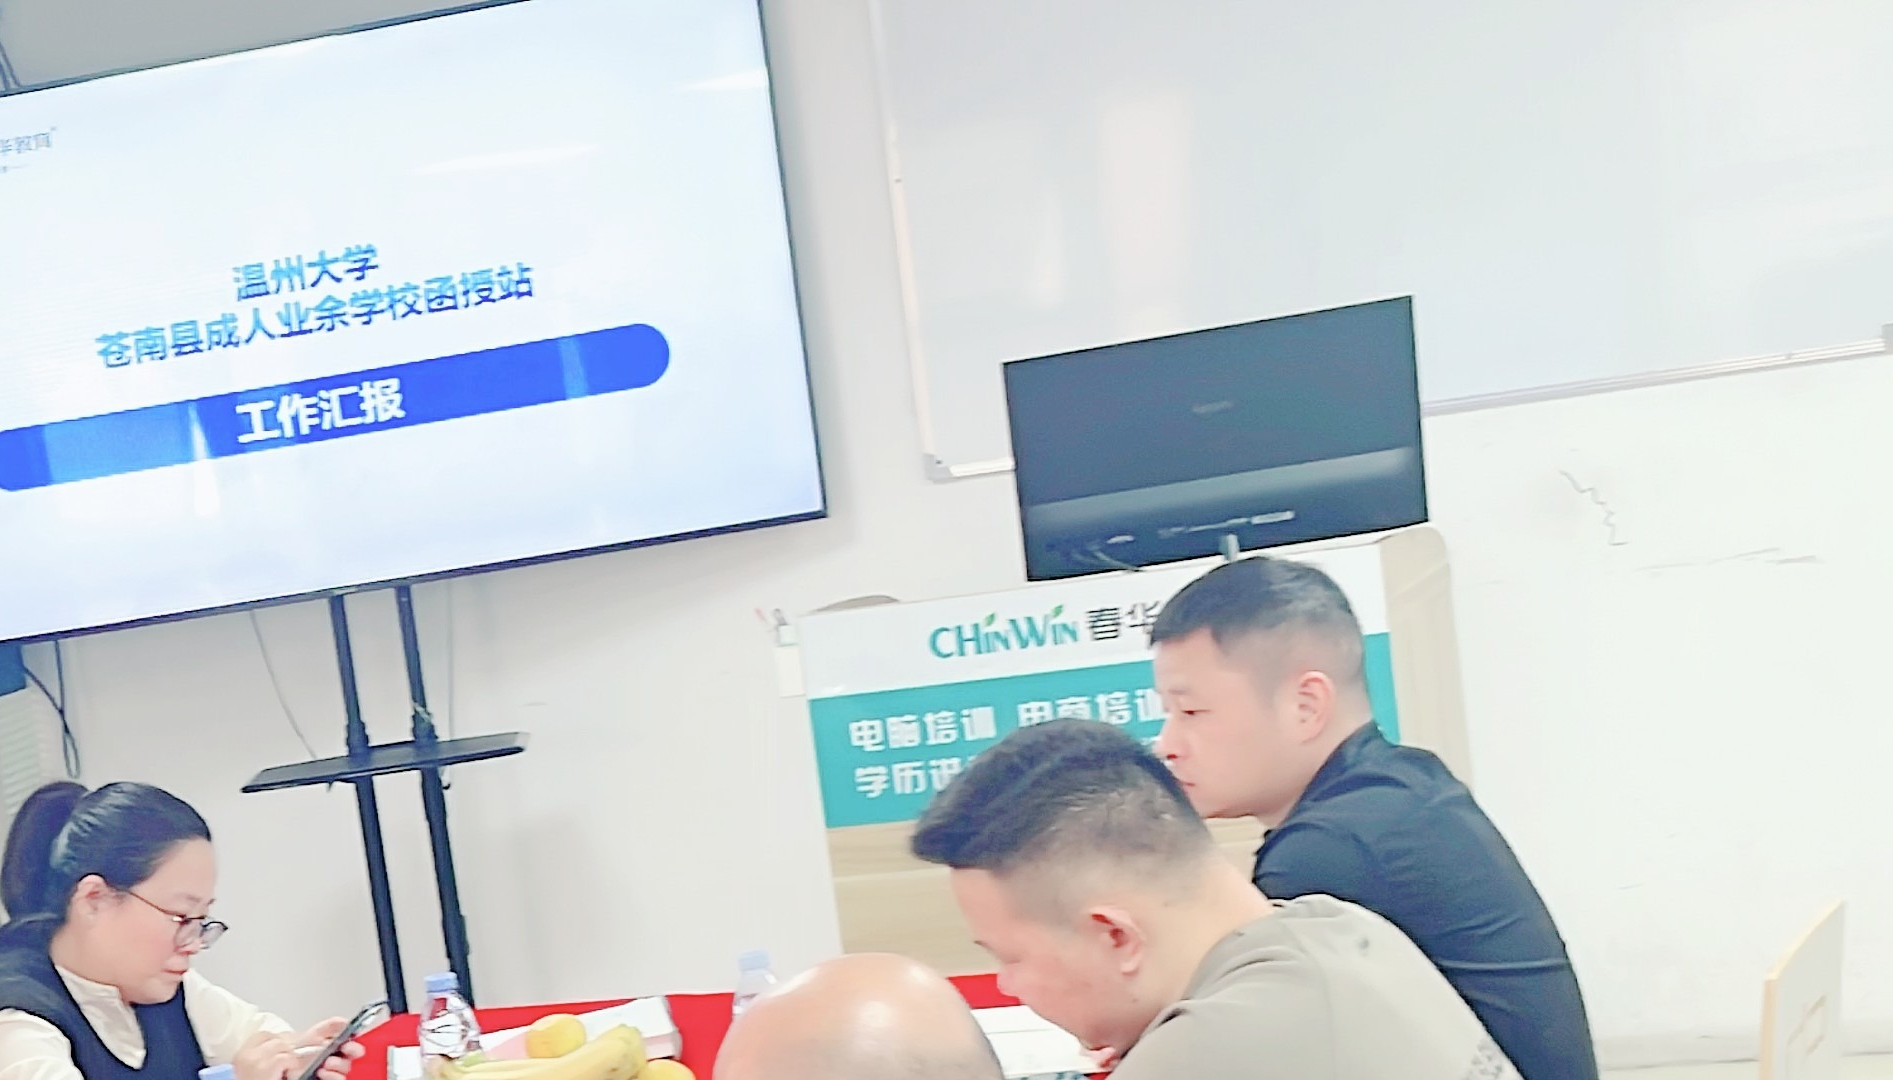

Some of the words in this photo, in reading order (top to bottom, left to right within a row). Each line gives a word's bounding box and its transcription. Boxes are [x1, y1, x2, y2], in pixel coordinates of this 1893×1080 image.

[232, 243, 379, 301] 温州大学
[95, 262, 535, 368] 苍南县成人业余学校函授站
[235, 377, 406, 443] 工作汇报
[849, 705, 997, 751] 电脑培训
